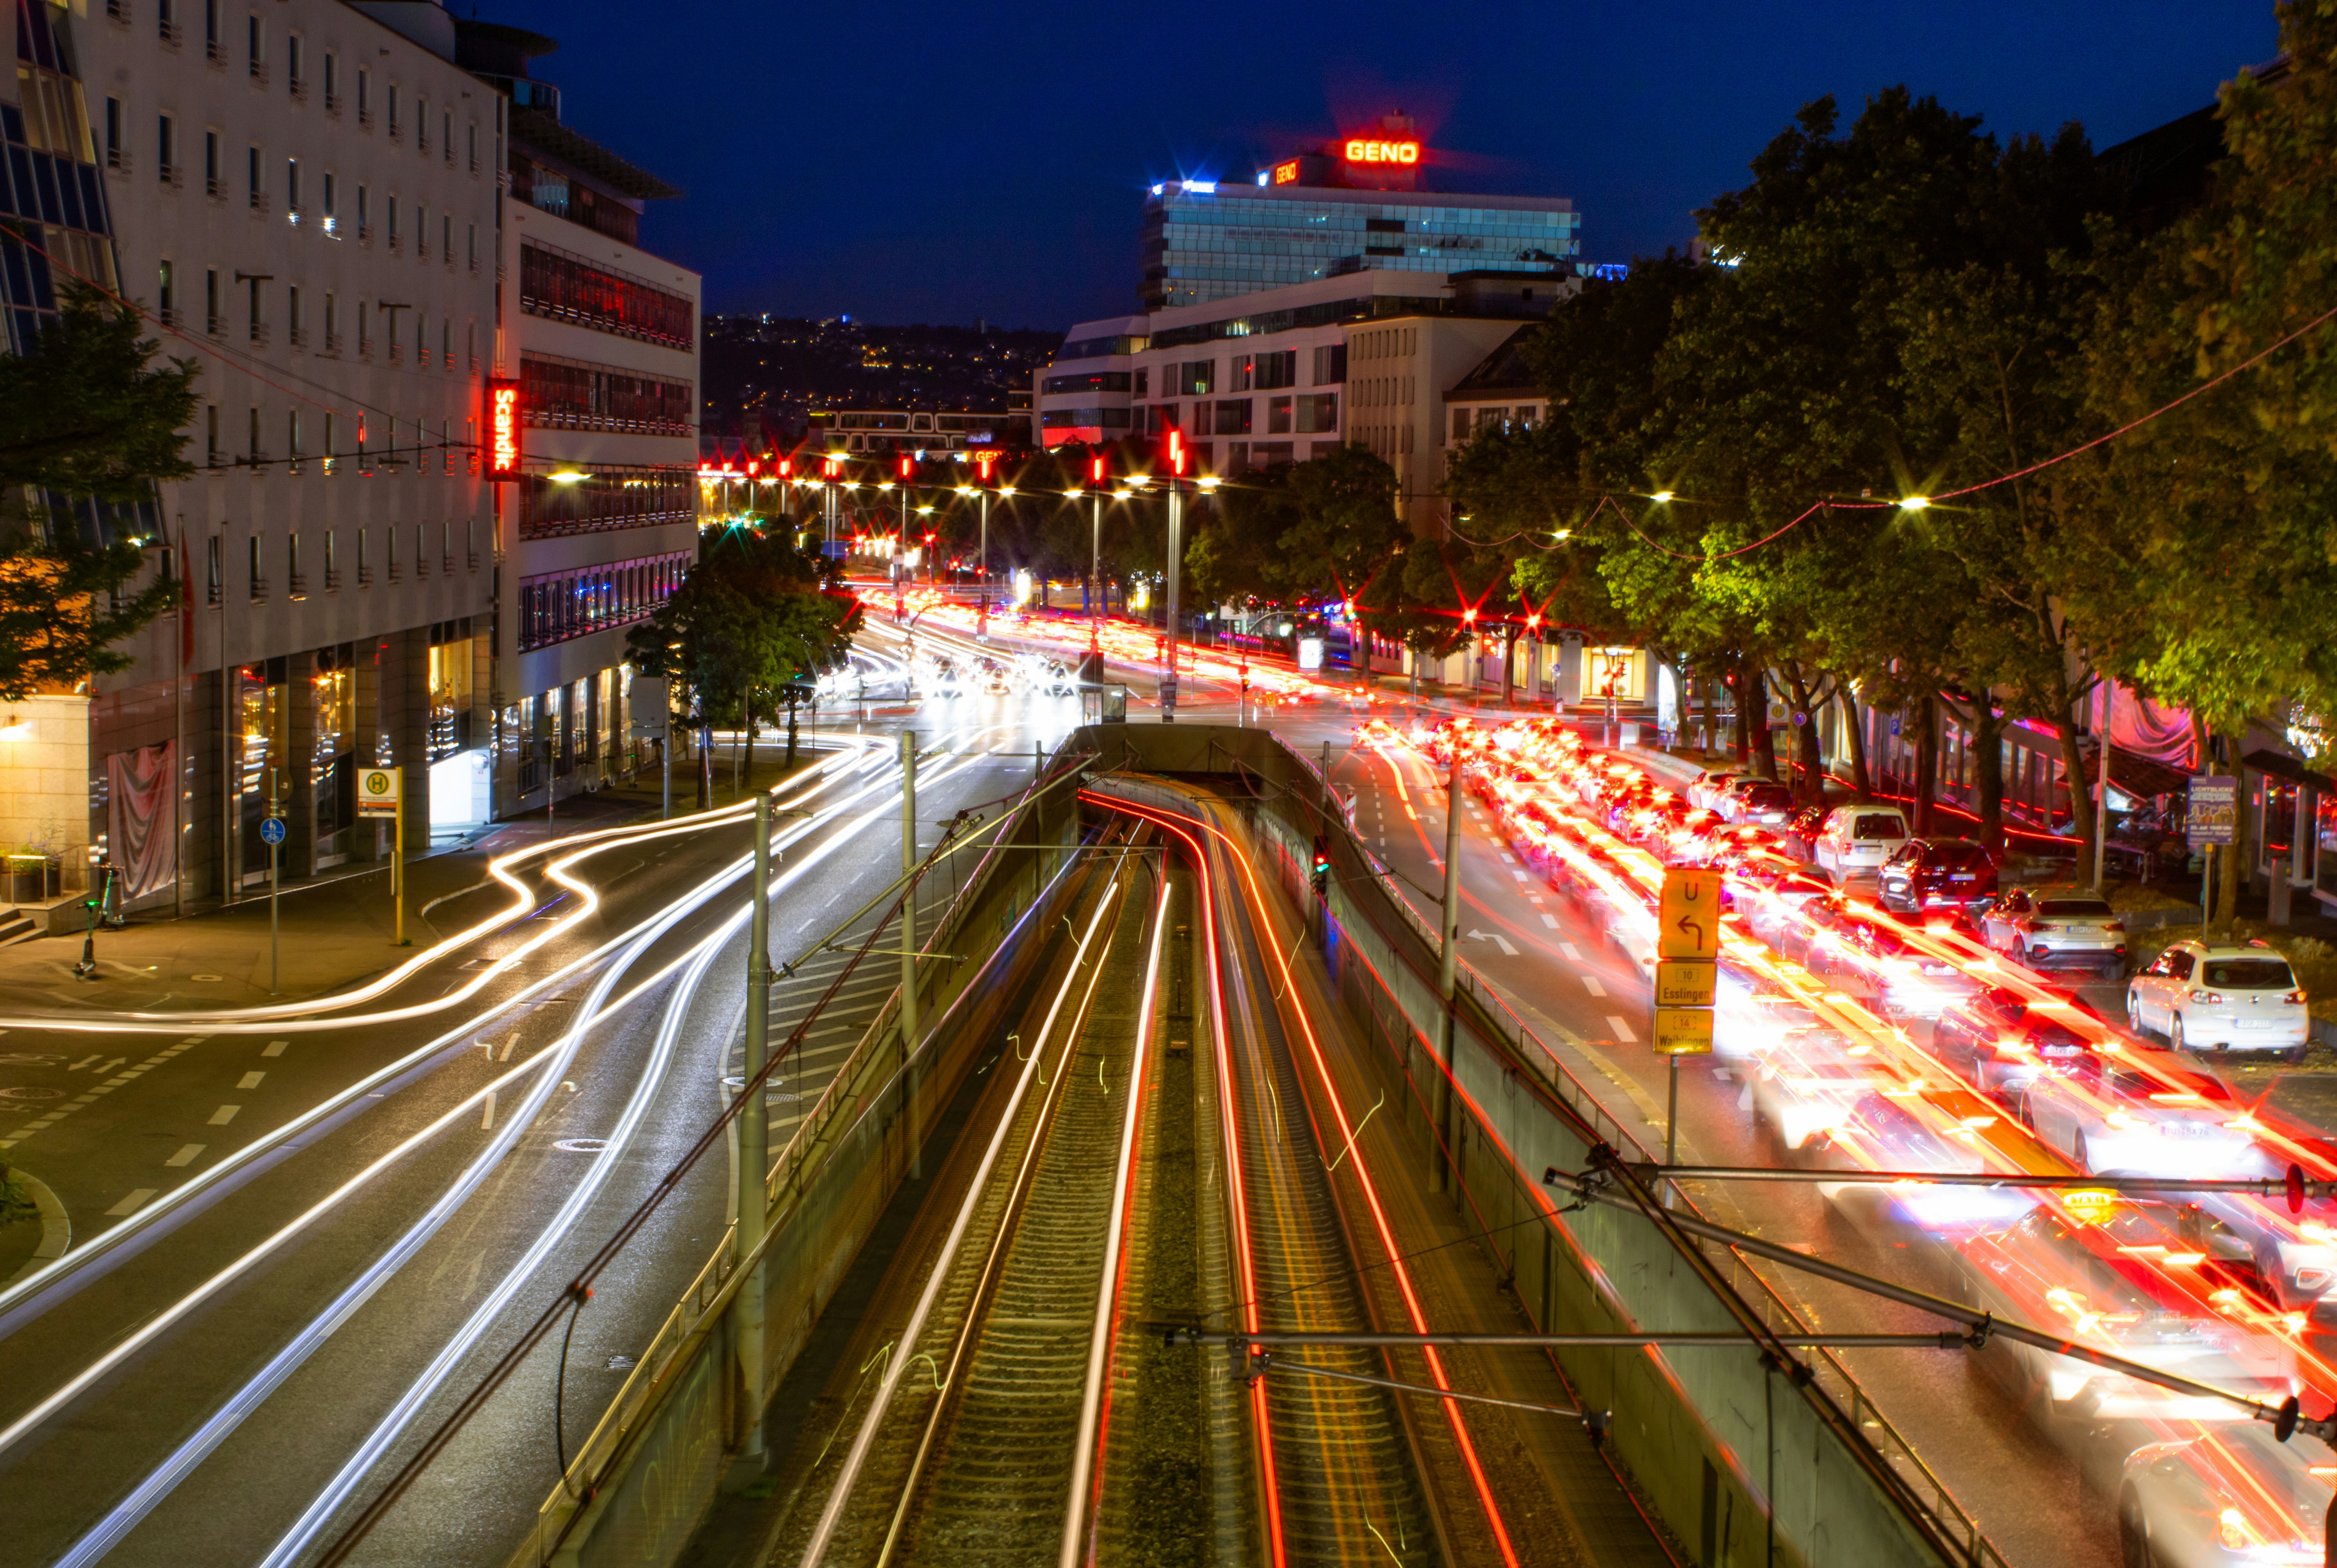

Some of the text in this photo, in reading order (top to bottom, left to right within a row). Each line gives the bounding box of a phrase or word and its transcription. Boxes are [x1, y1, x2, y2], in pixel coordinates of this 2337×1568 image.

[1347, 141, 1418, 163] GENO
[1276, 163, 1296, 184] GENO
[495, 389, 515, 470] Scandic
[372, 777, 383, 789] H
[1685, 882, 1698, 901] U
[1683, 971, 1692, 980] 10
[1663, 987, 1710, 1002] Esslingen
[1680, 1018, 1690, 1027] 14
[1659, 1035, 1709, 1049] Waiblingen
